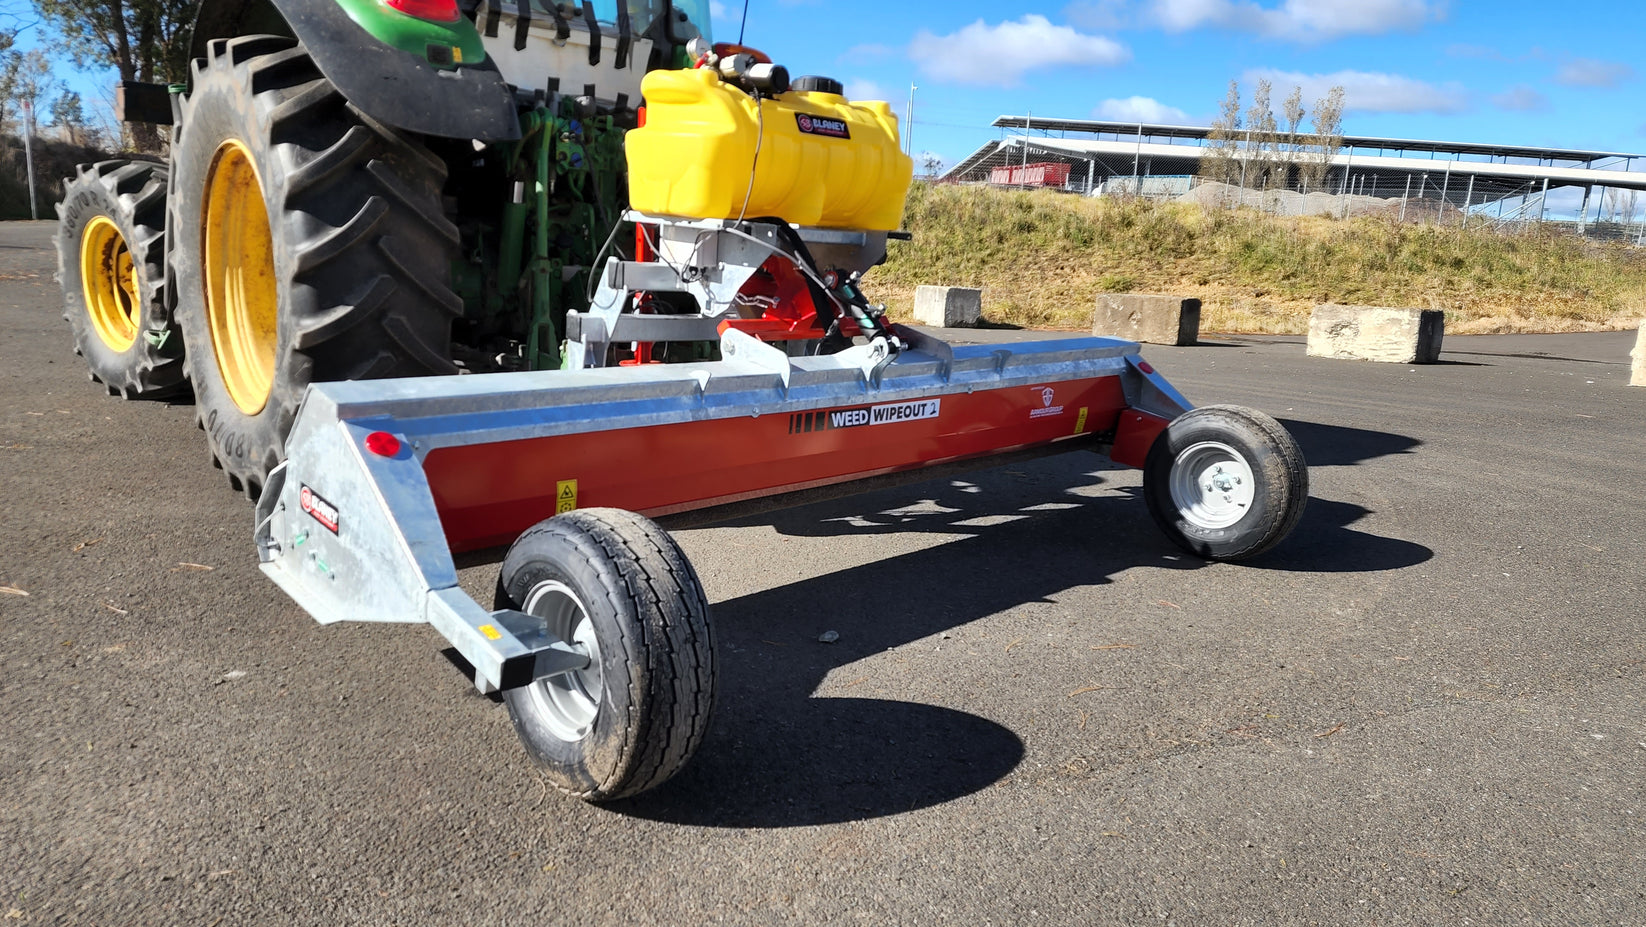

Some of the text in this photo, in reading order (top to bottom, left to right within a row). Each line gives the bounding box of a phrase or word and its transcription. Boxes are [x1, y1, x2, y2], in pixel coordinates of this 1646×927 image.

[812, 118, 846, 131] BLANEY
[831, 410, 869, 428] WEED
[873, 403, 927, 422] WIPEOUT
